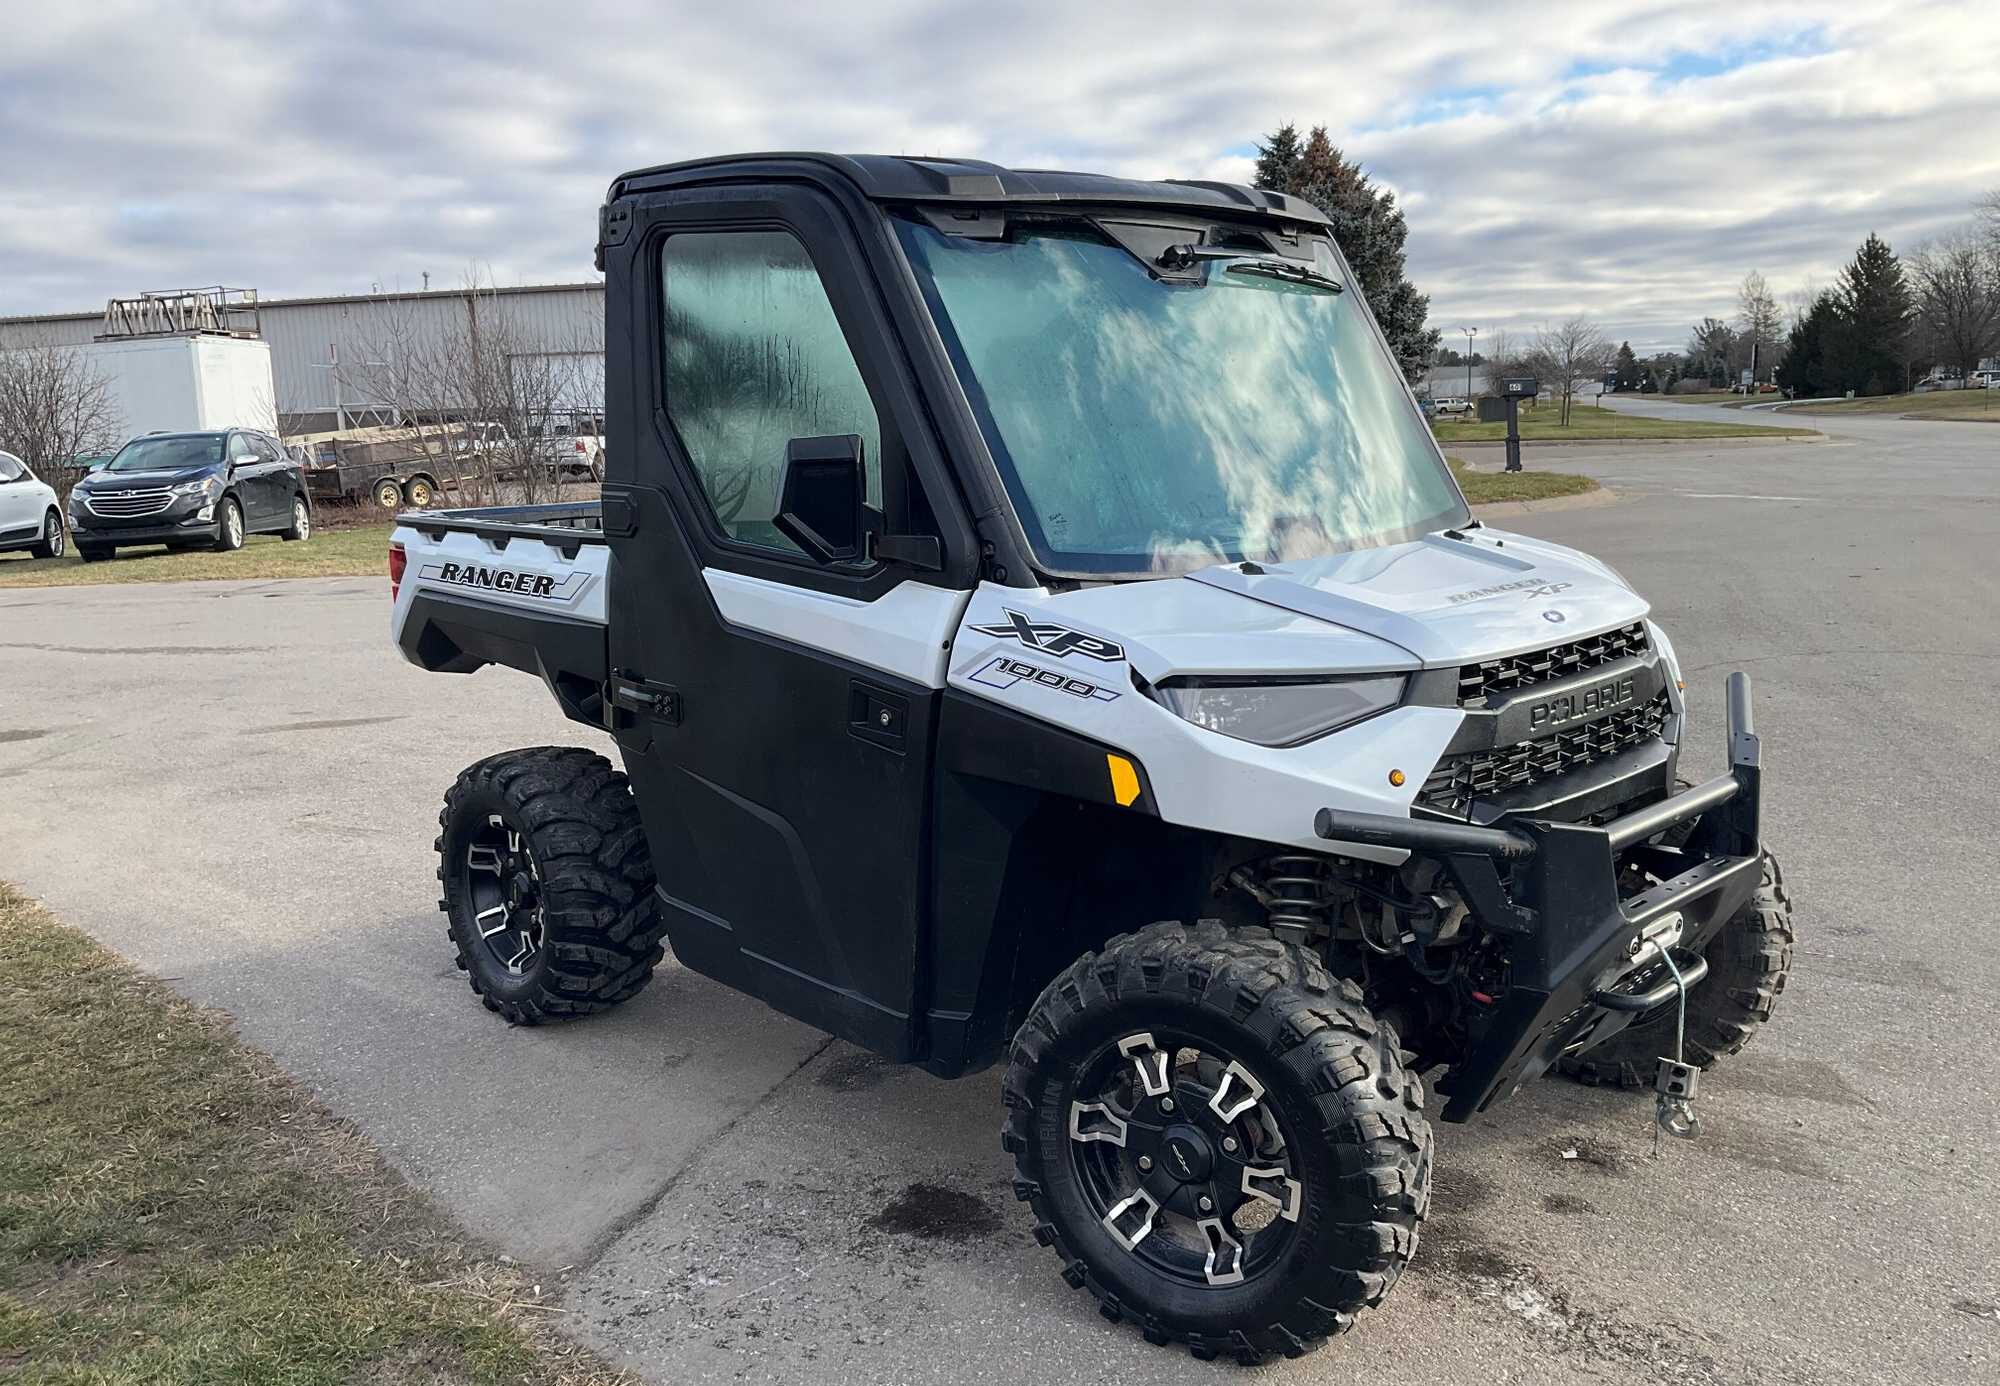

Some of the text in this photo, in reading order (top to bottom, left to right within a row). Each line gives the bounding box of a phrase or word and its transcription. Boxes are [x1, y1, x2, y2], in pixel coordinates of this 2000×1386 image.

[440, 561, 556, 599] RANGER
[1523, 582, 1573, 600] XP
[966, 607, 1126, 662] XP
[995, 656, 1097, 698] 1000
[1530, 675, 1634, 733] POLARIS
